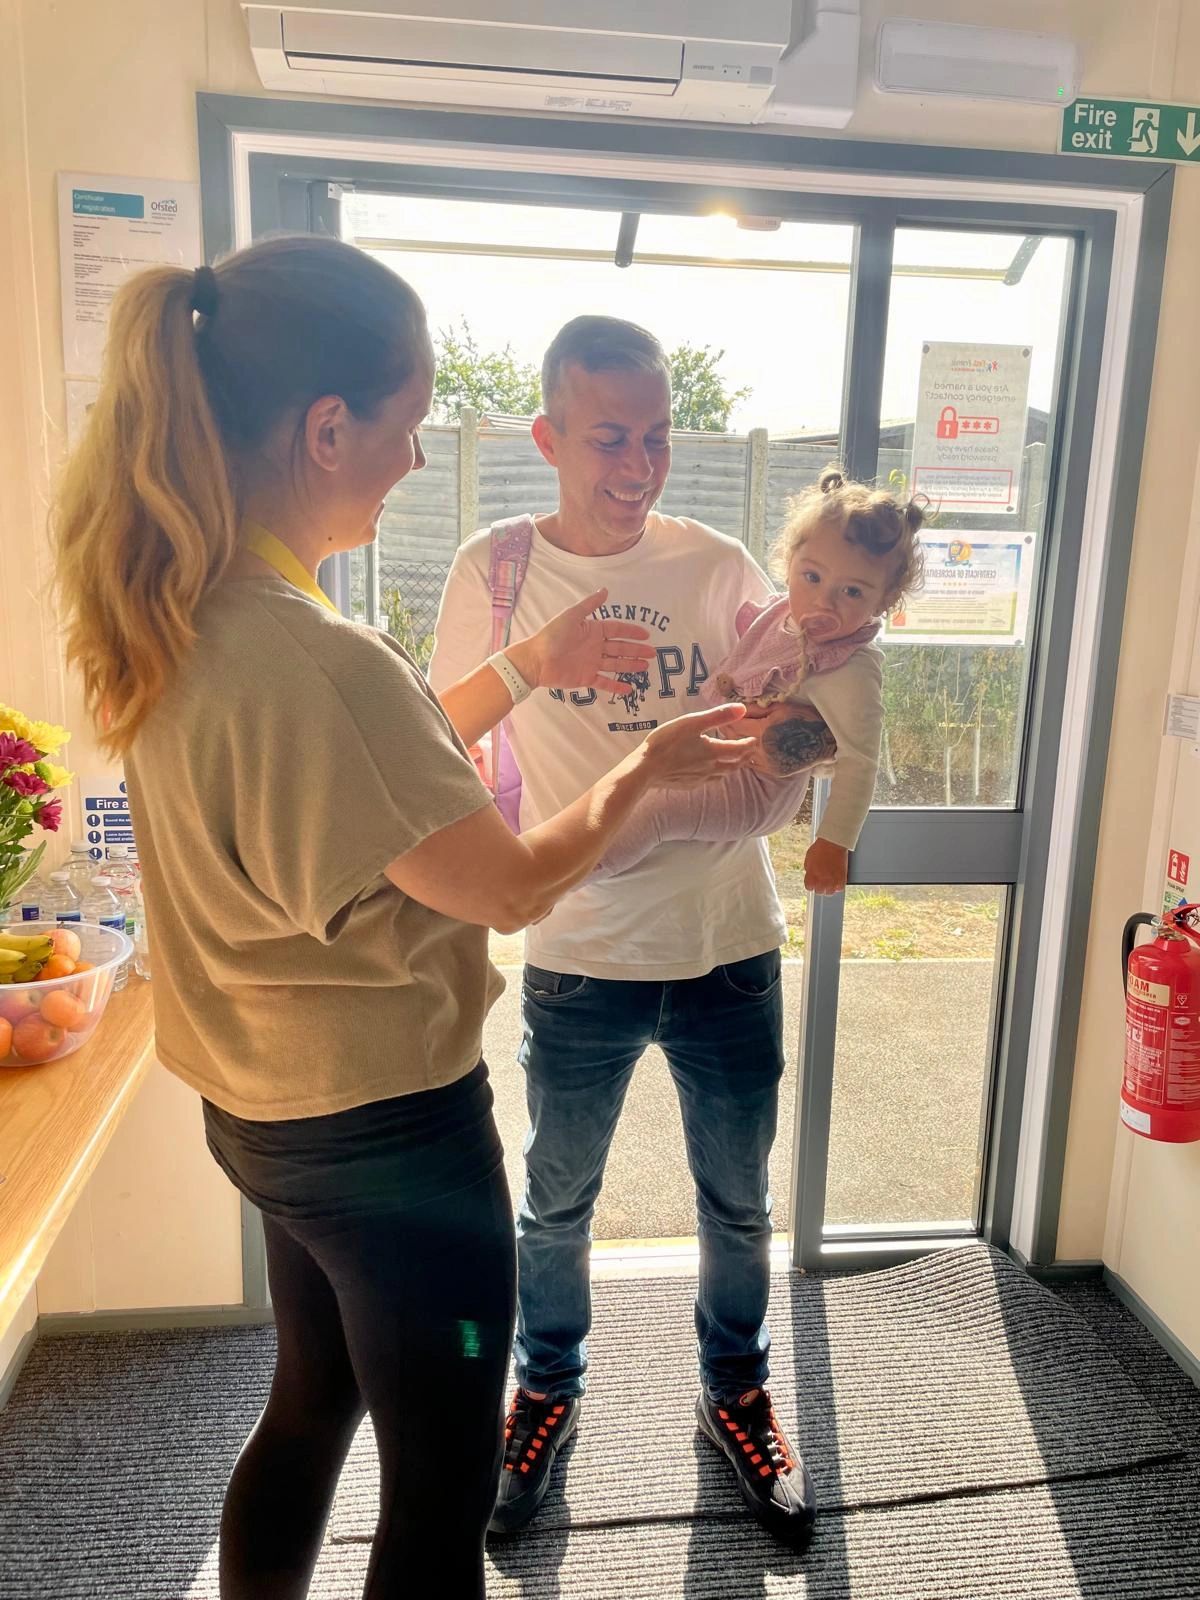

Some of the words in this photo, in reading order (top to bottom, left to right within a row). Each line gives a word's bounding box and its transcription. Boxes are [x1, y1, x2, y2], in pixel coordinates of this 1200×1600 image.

[1074, 103, 1117, 127] Fire
[1071, 129, 1113, 150] exit
[150, 201, 178, 213] Ofsted
[635, 722, 652, 730] 1890
[96, 799, 119, 809] Fire
[1128, 976, 1150, 993] OAM
